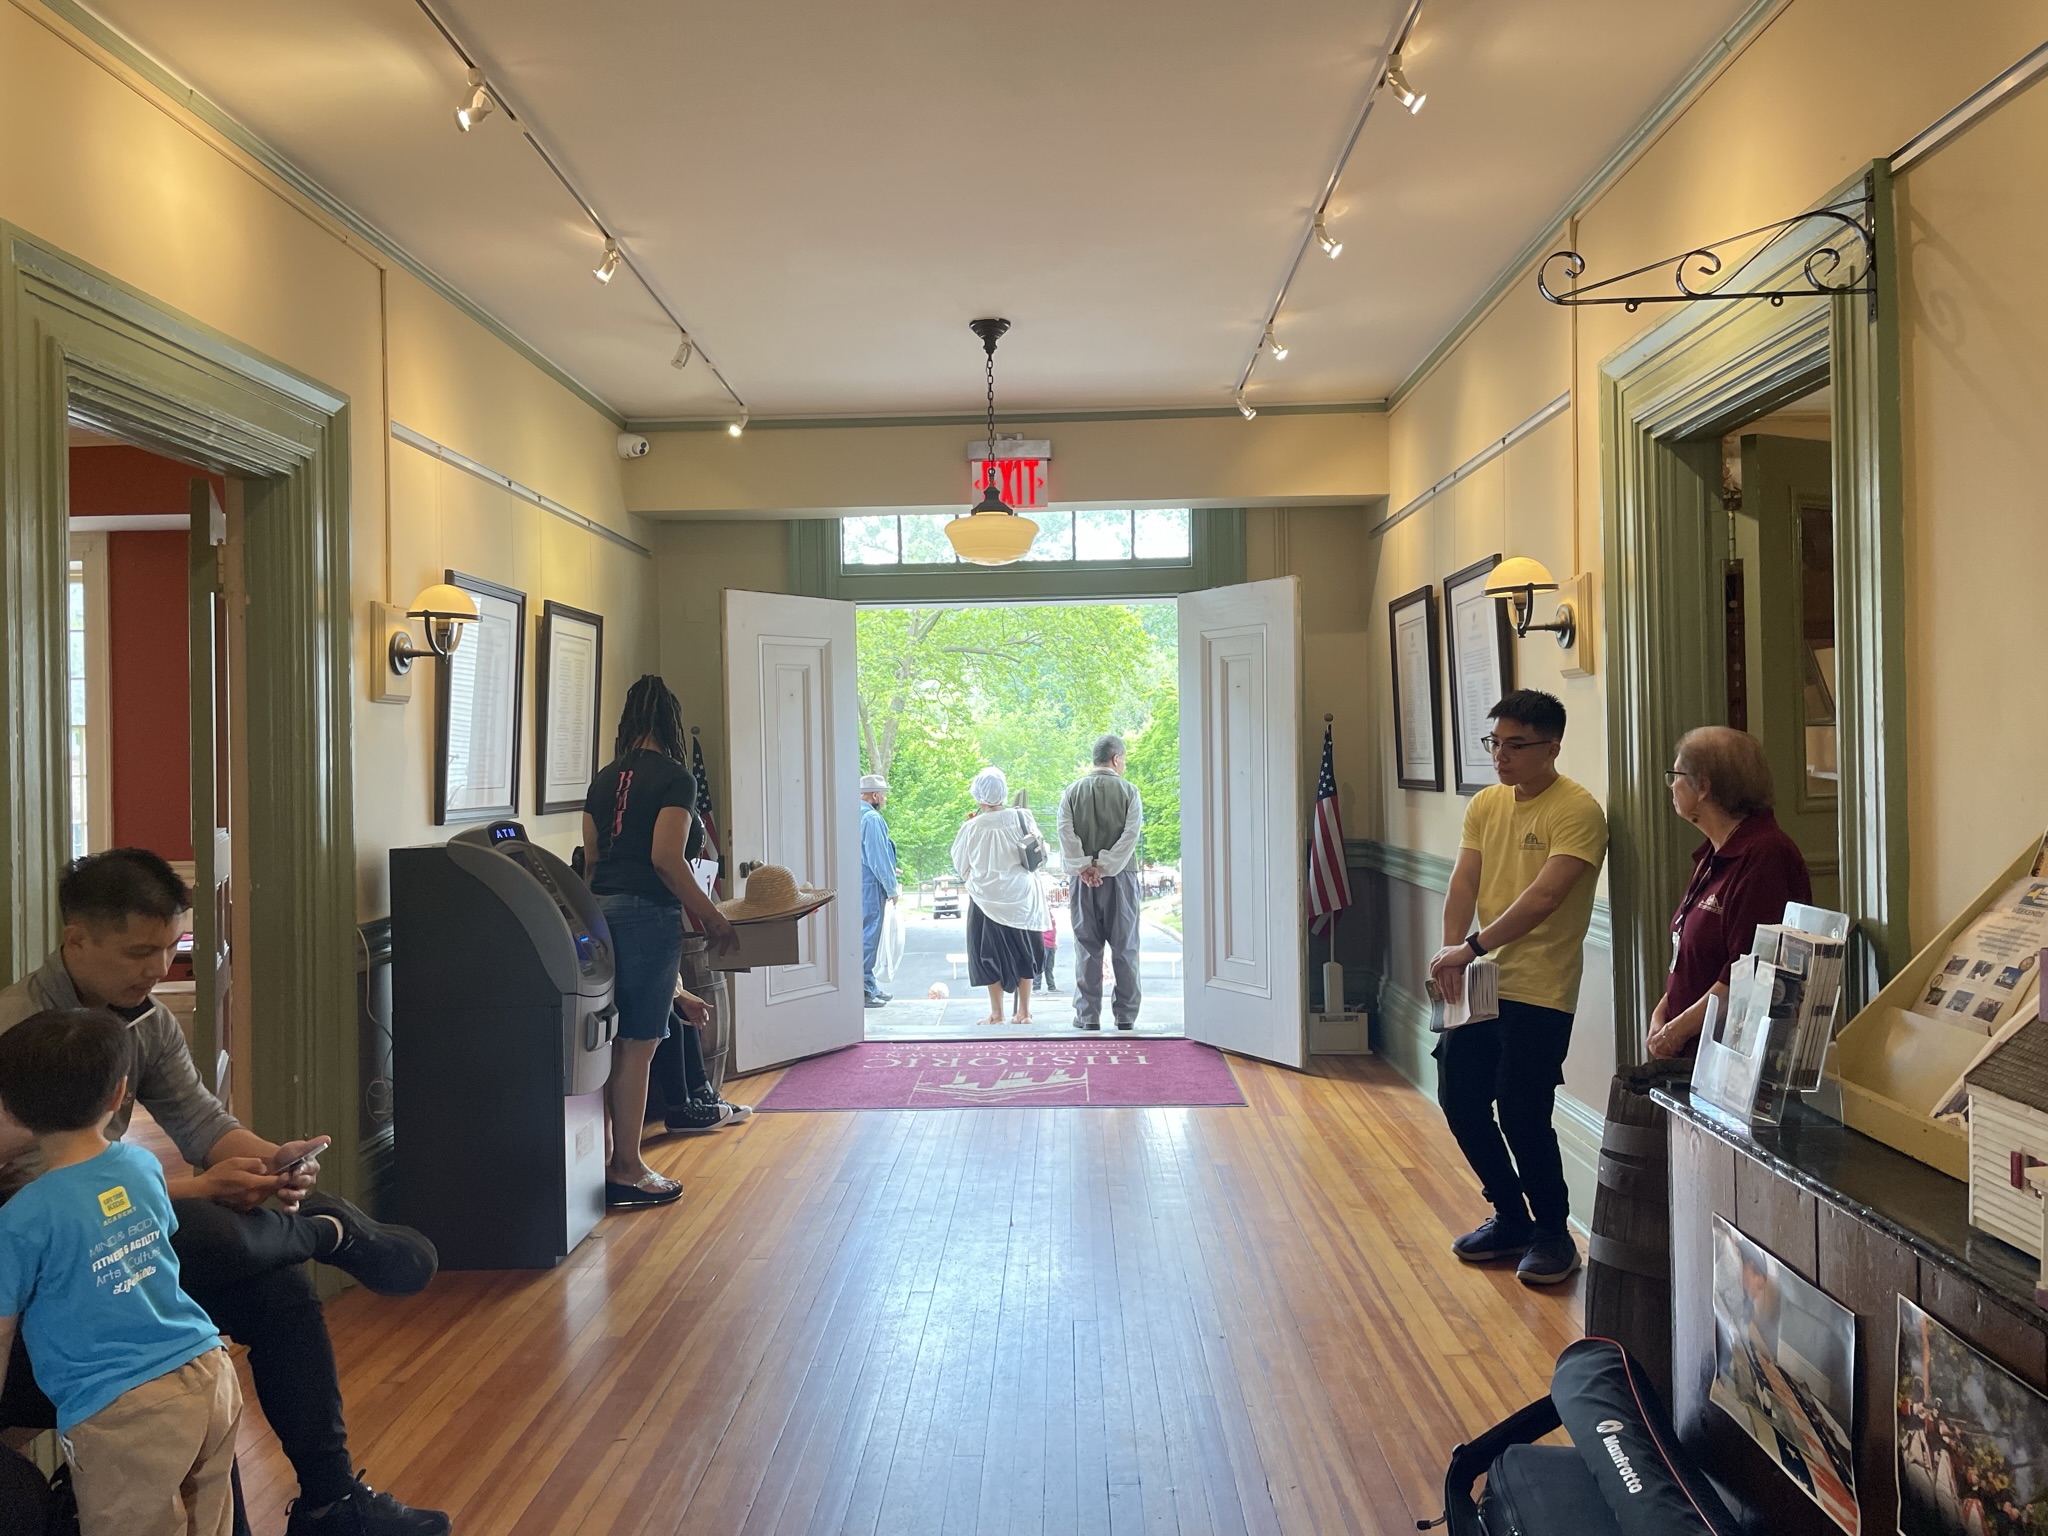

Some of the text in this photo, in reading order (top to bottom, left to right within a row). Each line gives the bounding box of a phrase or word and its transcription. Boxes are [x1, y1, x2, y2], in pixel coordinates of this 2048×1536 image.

[982, 459, 1039, 505] EXIT
[496, 828, 516, 839] ATM
[863, 1055, 1153, 1069] HISTORIC
[128, 1219, 156, 1237] BOD
[96, 1269, 121, 1287] Arts
[1602, 1434, 1643, 1494] Manfrotto
